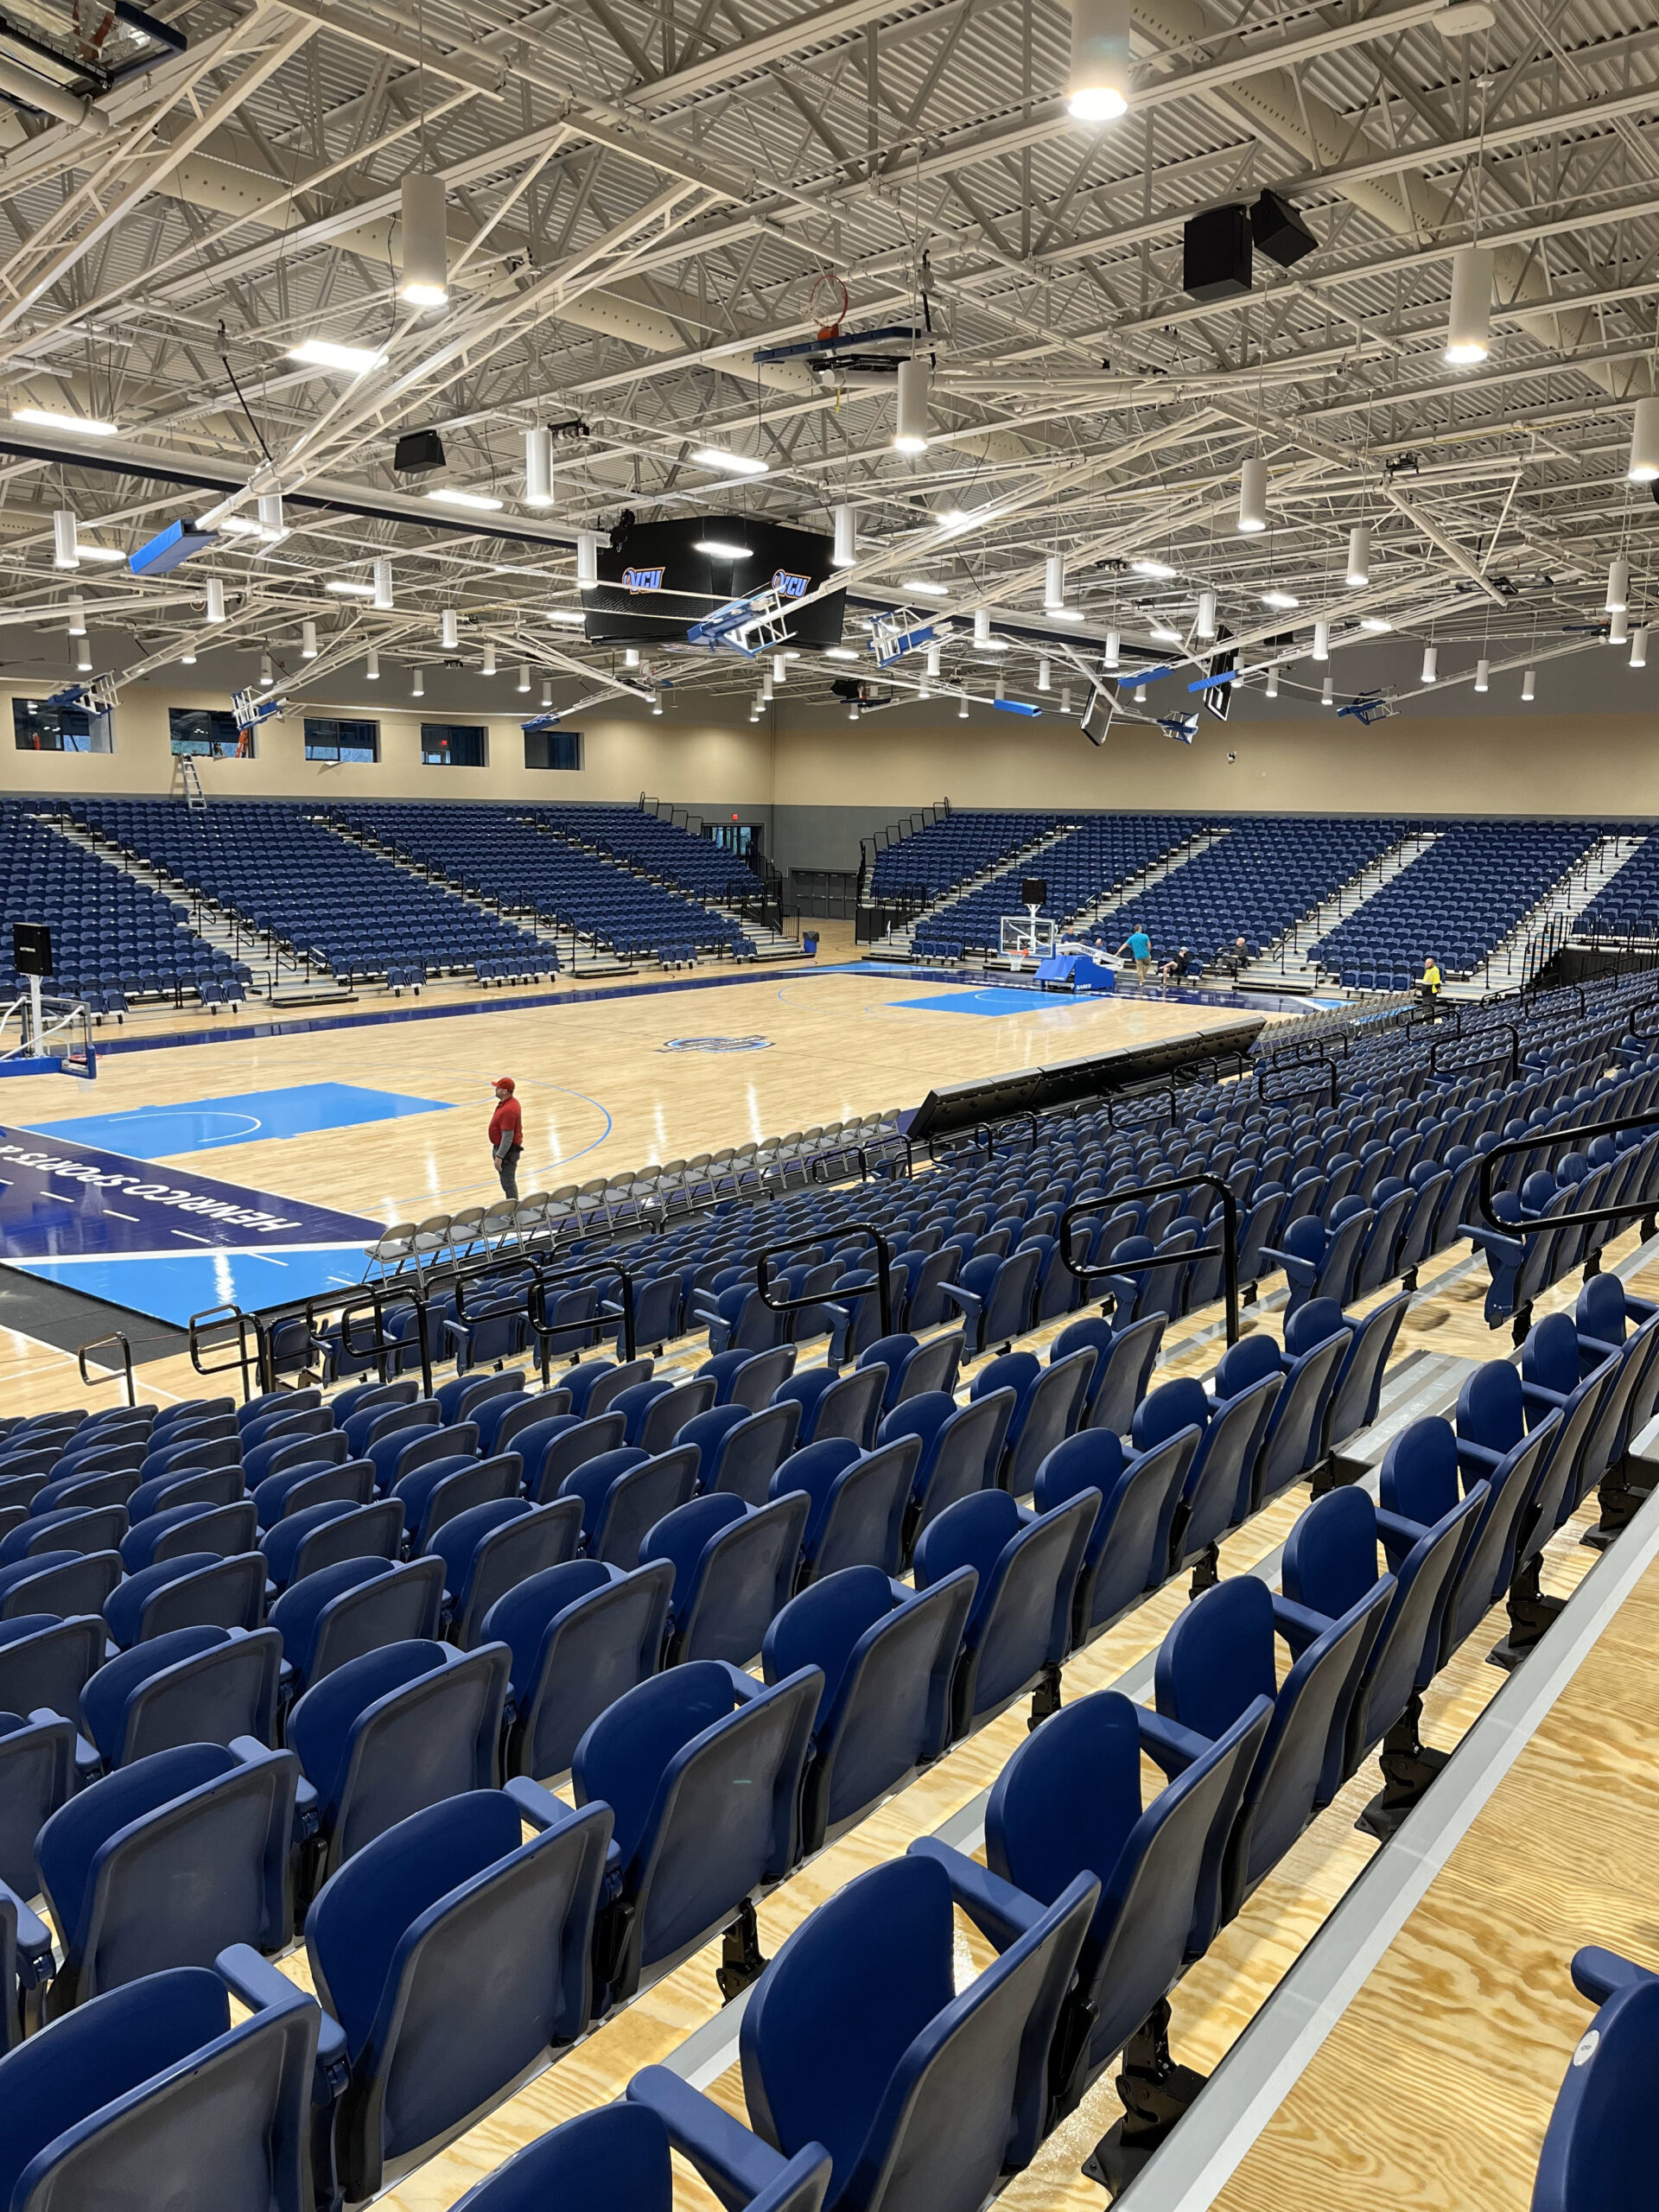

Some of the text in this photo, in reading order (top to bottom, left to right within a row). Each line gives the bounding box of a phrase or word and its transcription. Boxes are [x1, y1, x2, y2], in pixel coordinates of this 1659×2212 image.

[627, 569, 663, 592] VCU
[778, 571, 809, 597] VCU
[3, 1153, 141, 1187] SPORTS
[123, 1185, 302, 1232] HENRICO
